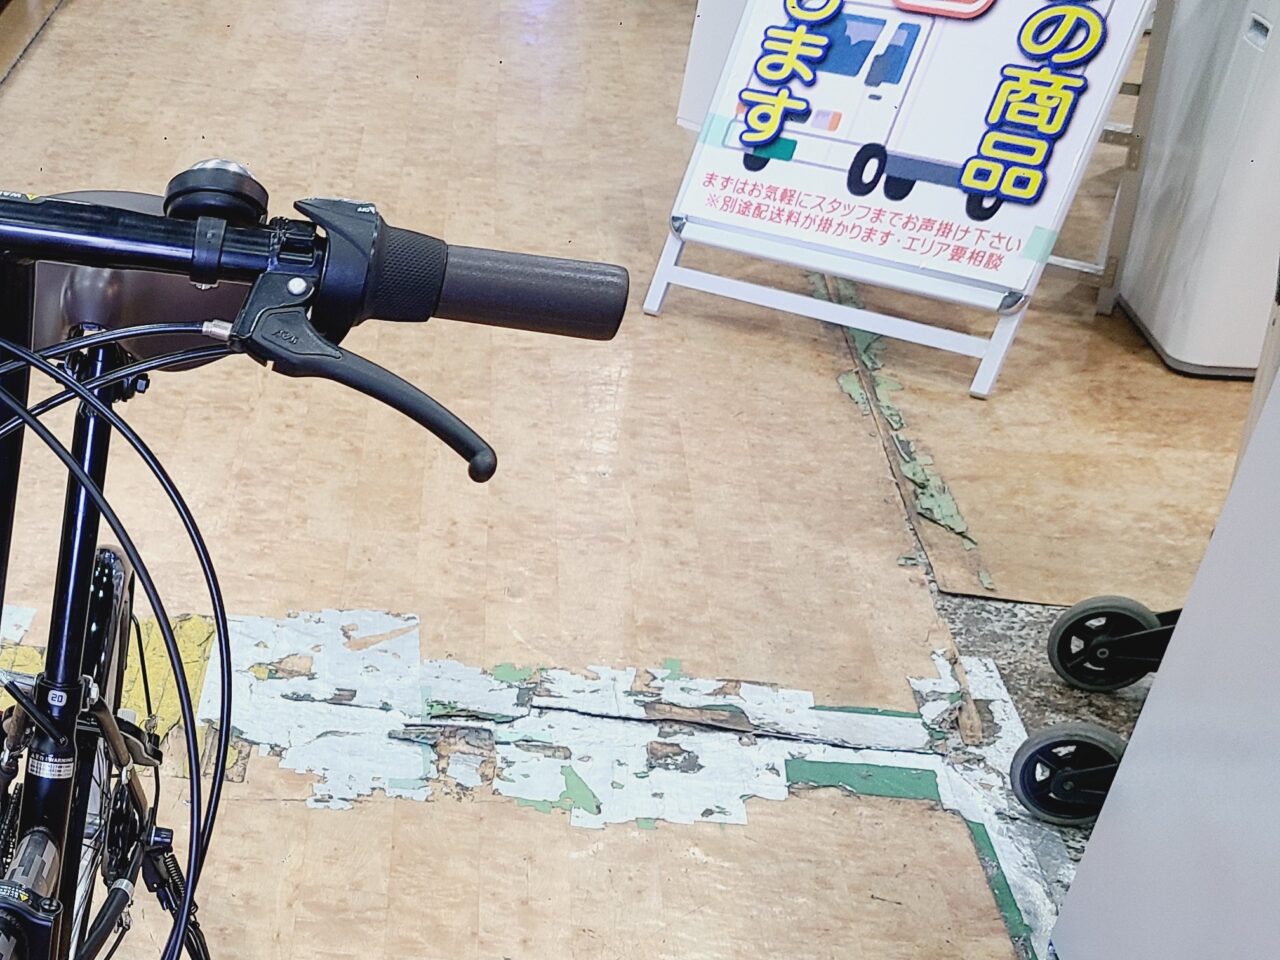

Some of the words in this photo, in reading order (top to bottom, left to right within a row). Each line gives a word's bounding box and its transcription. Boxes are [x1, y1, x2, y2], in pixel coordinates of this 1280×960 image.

[960, 3, 1108, 206] の商品
[702, 172, 1022, 252] まずはお気軽にスタッフまでお声掛け下さい
[51, 693, 63, 703] 20
